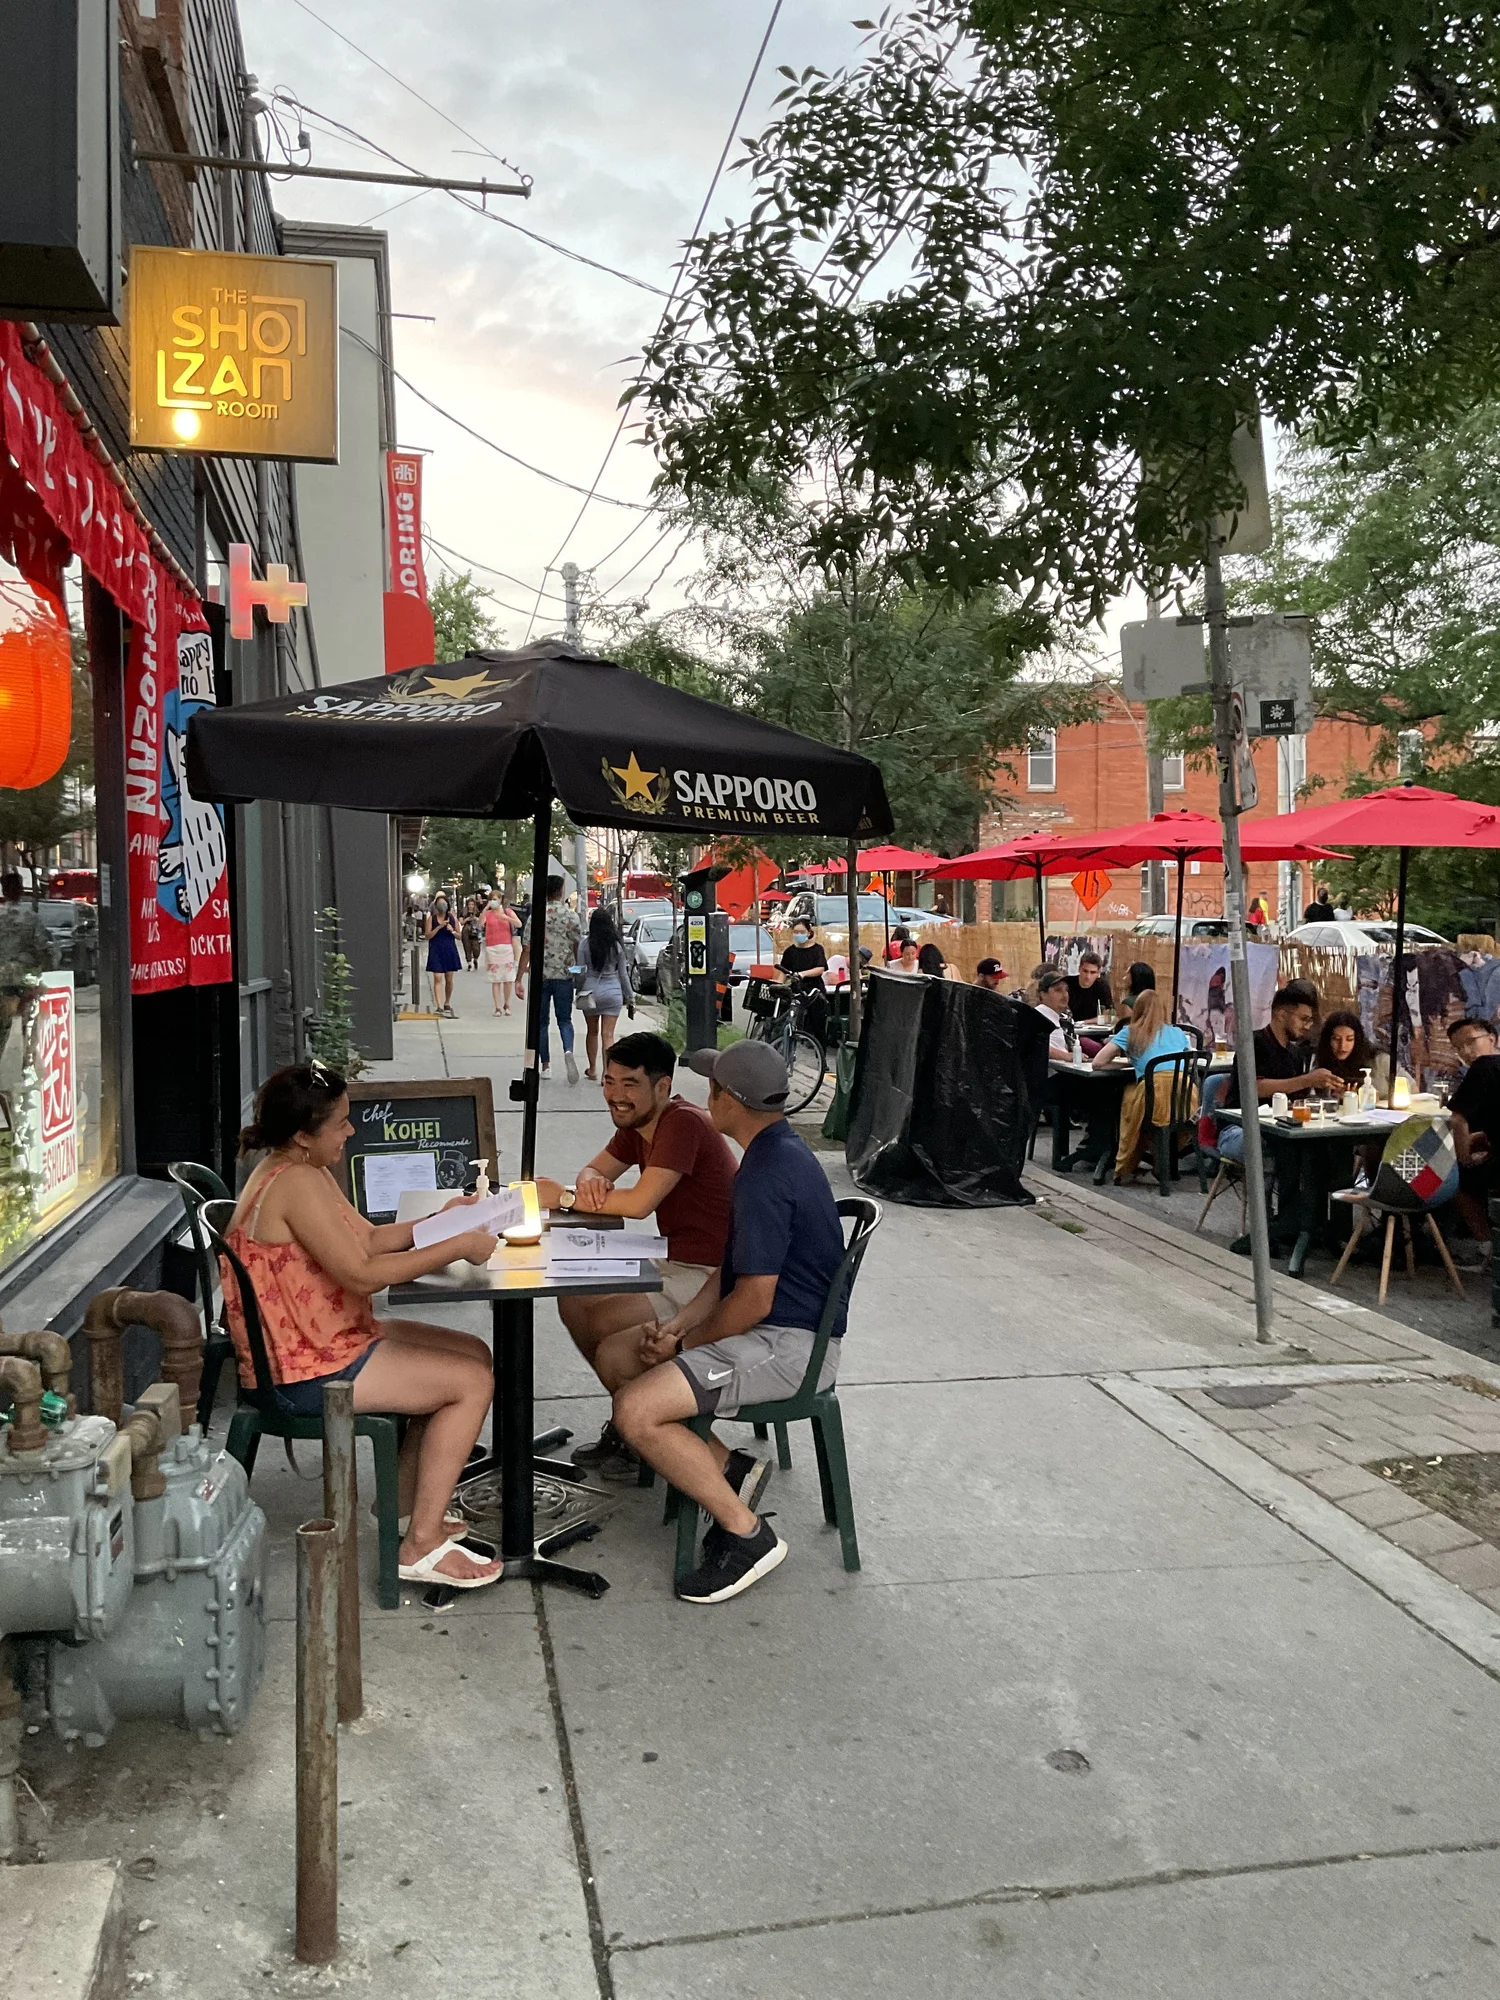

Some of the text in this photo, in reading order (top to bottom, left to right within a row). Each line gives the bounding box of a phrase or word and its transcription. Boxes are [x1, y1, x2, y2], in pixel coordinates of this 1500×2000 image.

[212, 287, 248, 305] THE
[216, 400, 279, 419] ROOM
[181, 675, 199, 695] no
[285, 710, 404, 722] PREMIUM
[297, 695, 503, 718] SAPPORO
[673, 769, 818, 812] SAPPORO
[682, 804, 820, 825] PREMIUM BEER
[362, 1101, 394, 1123] Chef
[384, 1121, 441, 1140] KOHEI
[47, 1134, 75, 1190] SHOZAN
